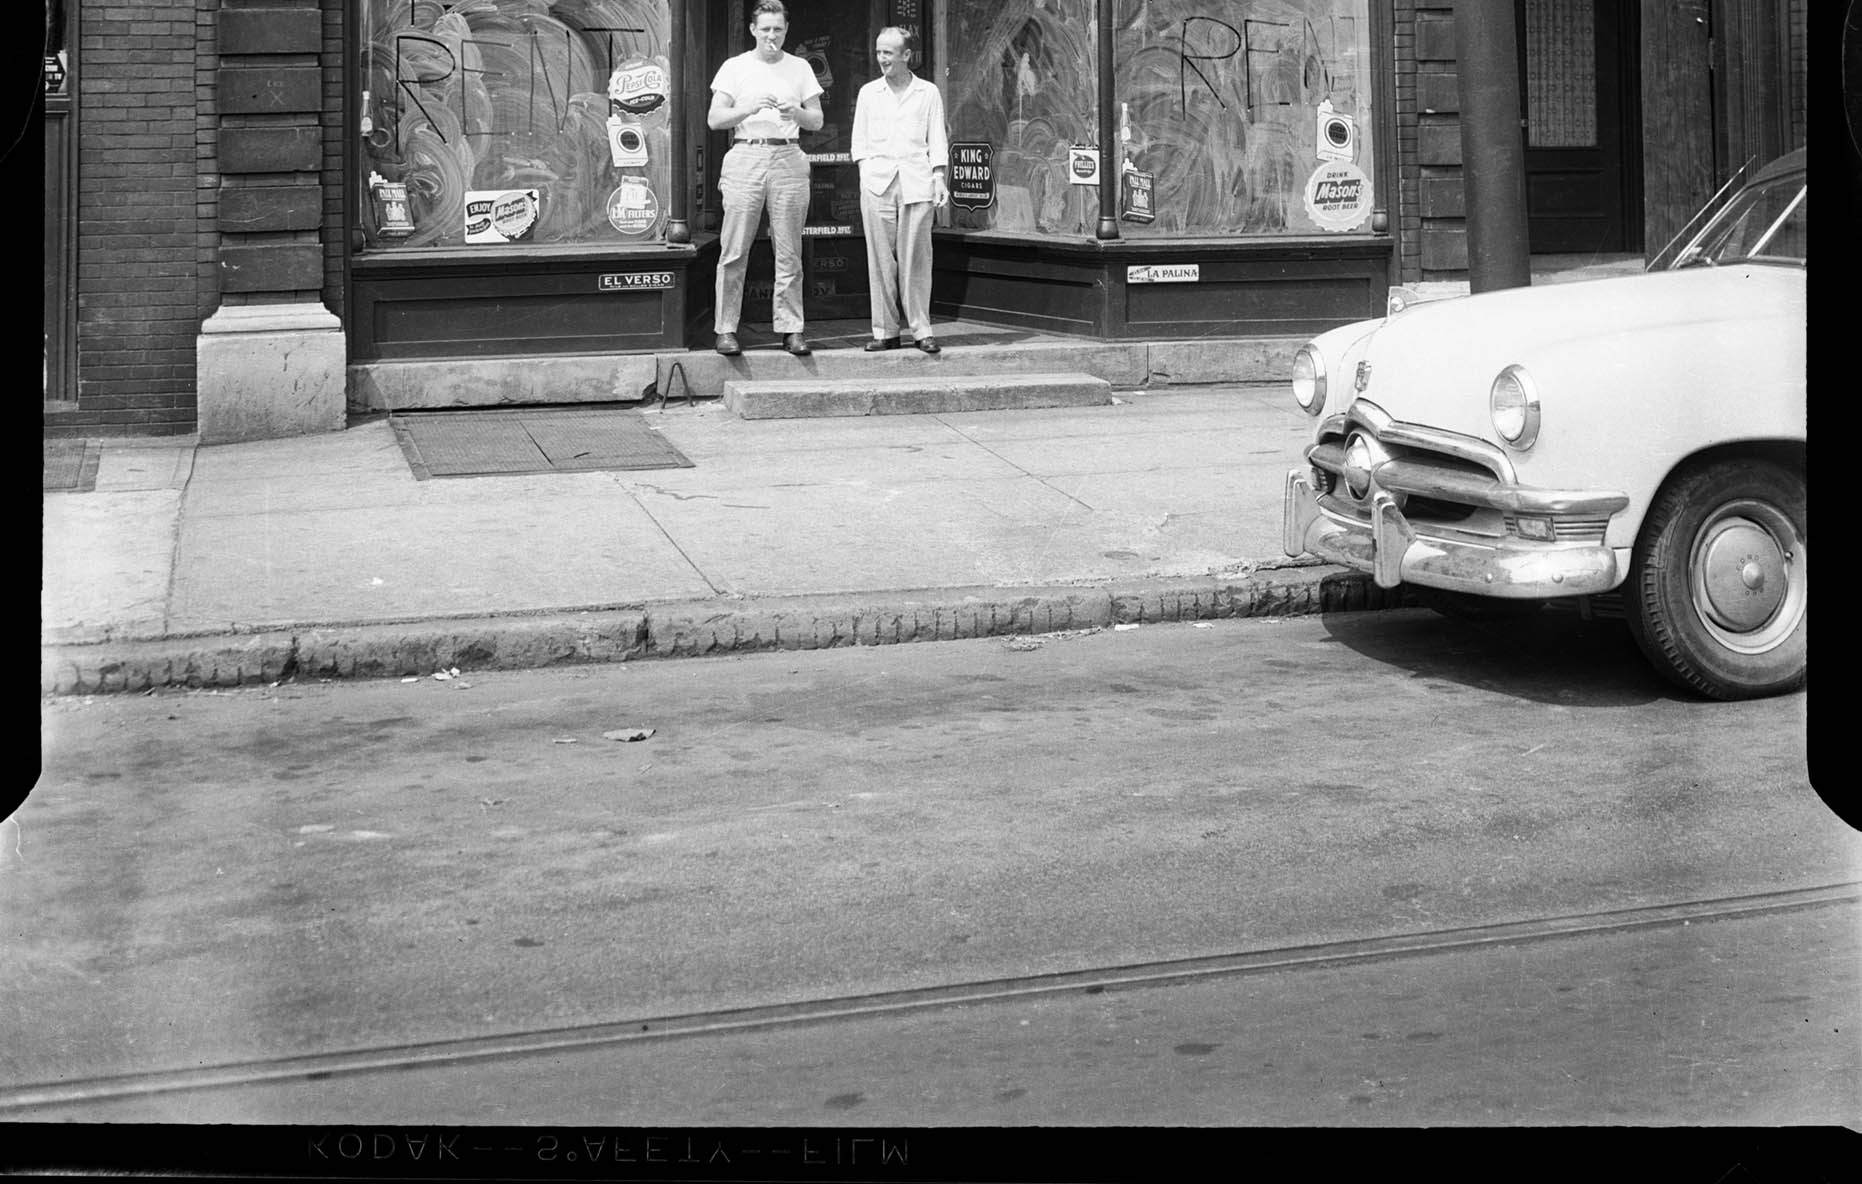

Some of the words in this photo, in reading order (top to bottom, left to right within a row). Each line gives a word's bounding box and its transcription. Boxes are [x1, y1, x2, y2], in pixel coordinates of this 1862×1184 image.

[396, 26, 645, 154] RENT
[960, 149, 982, 163] KING
[953, 165, 990, 180] EDWARD
[1316, 181, 1362, 201] Mason's
[604, 276, 621, 285] EL
[625, 274, 671, 284] VERSO
[1147, 270, 1159, 278] LA
[1162, 268, 1198, 278] PALINA
